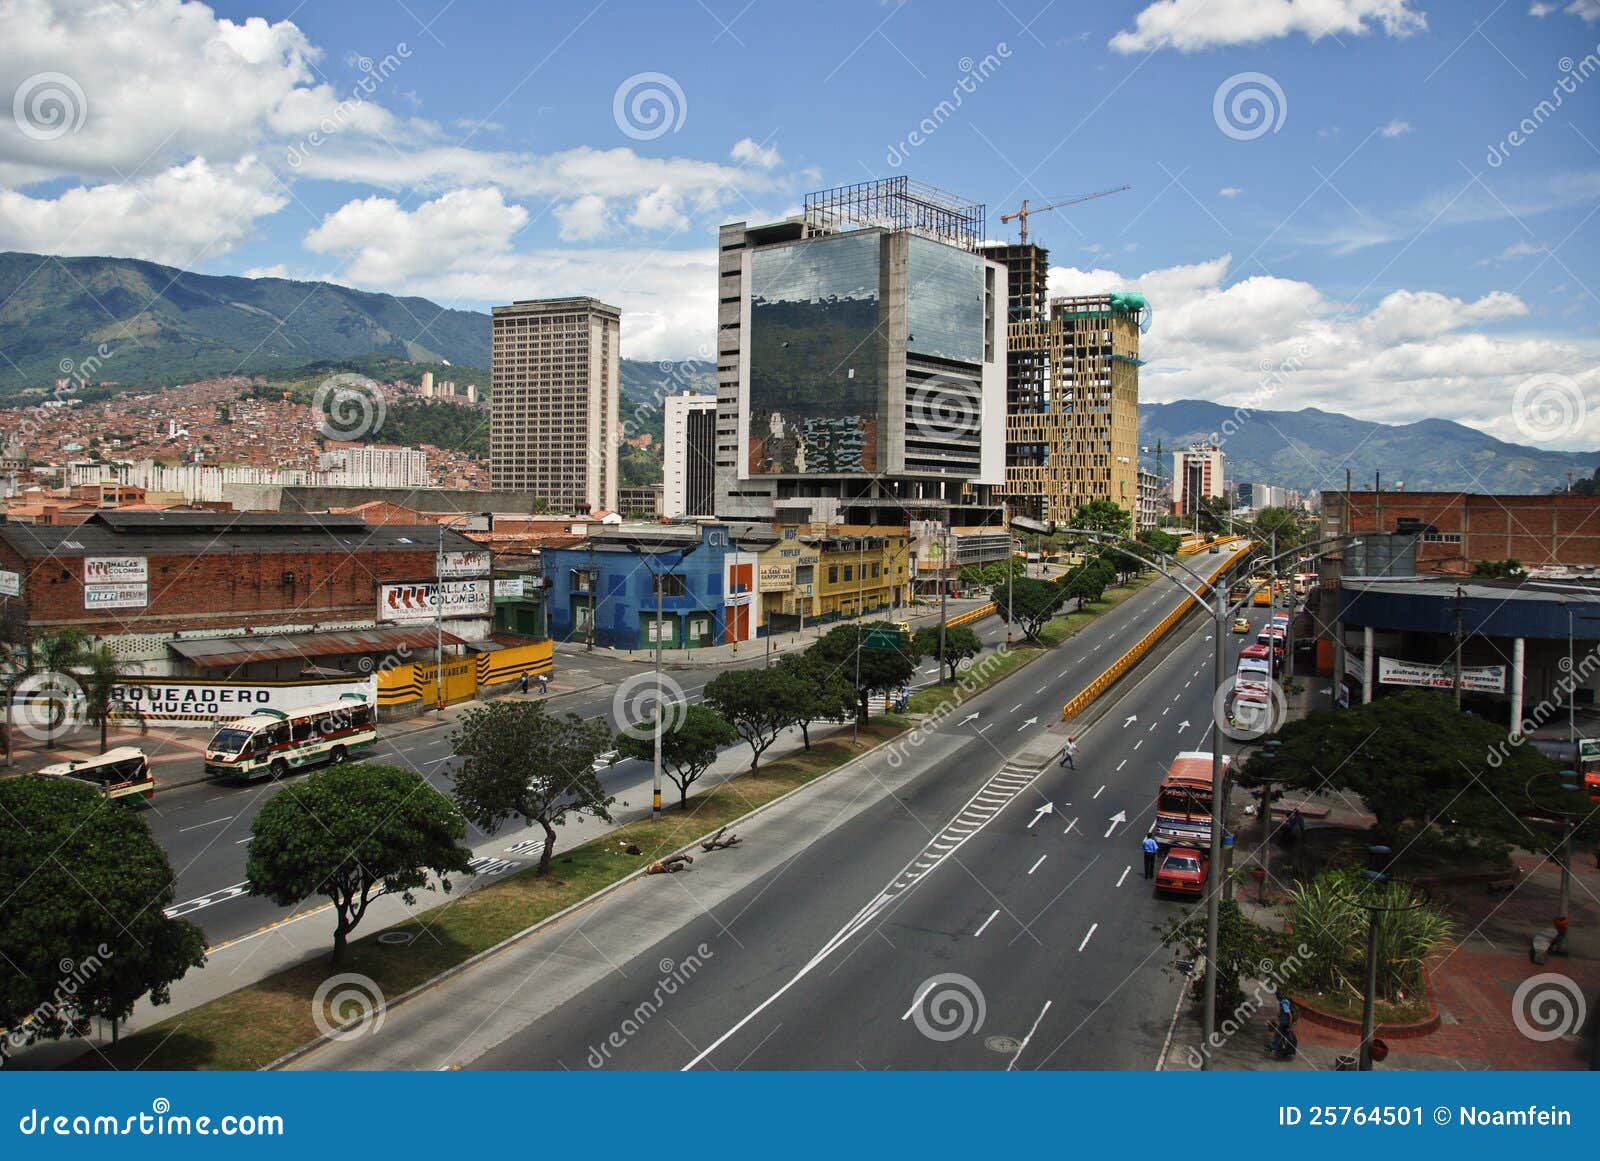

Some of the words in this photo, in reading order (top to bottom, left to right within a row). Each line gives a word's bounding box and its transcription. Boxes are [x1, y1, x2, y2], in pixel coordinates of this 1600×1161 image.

[430, 584, 476, 595] MALLAS
[430, 593, 487, 605] COLOMBIA
[111, 687, 271, 703] RQUEADERO
[125, 702, 146, 713] EL
[152, 702, 219, 714] HUECO
